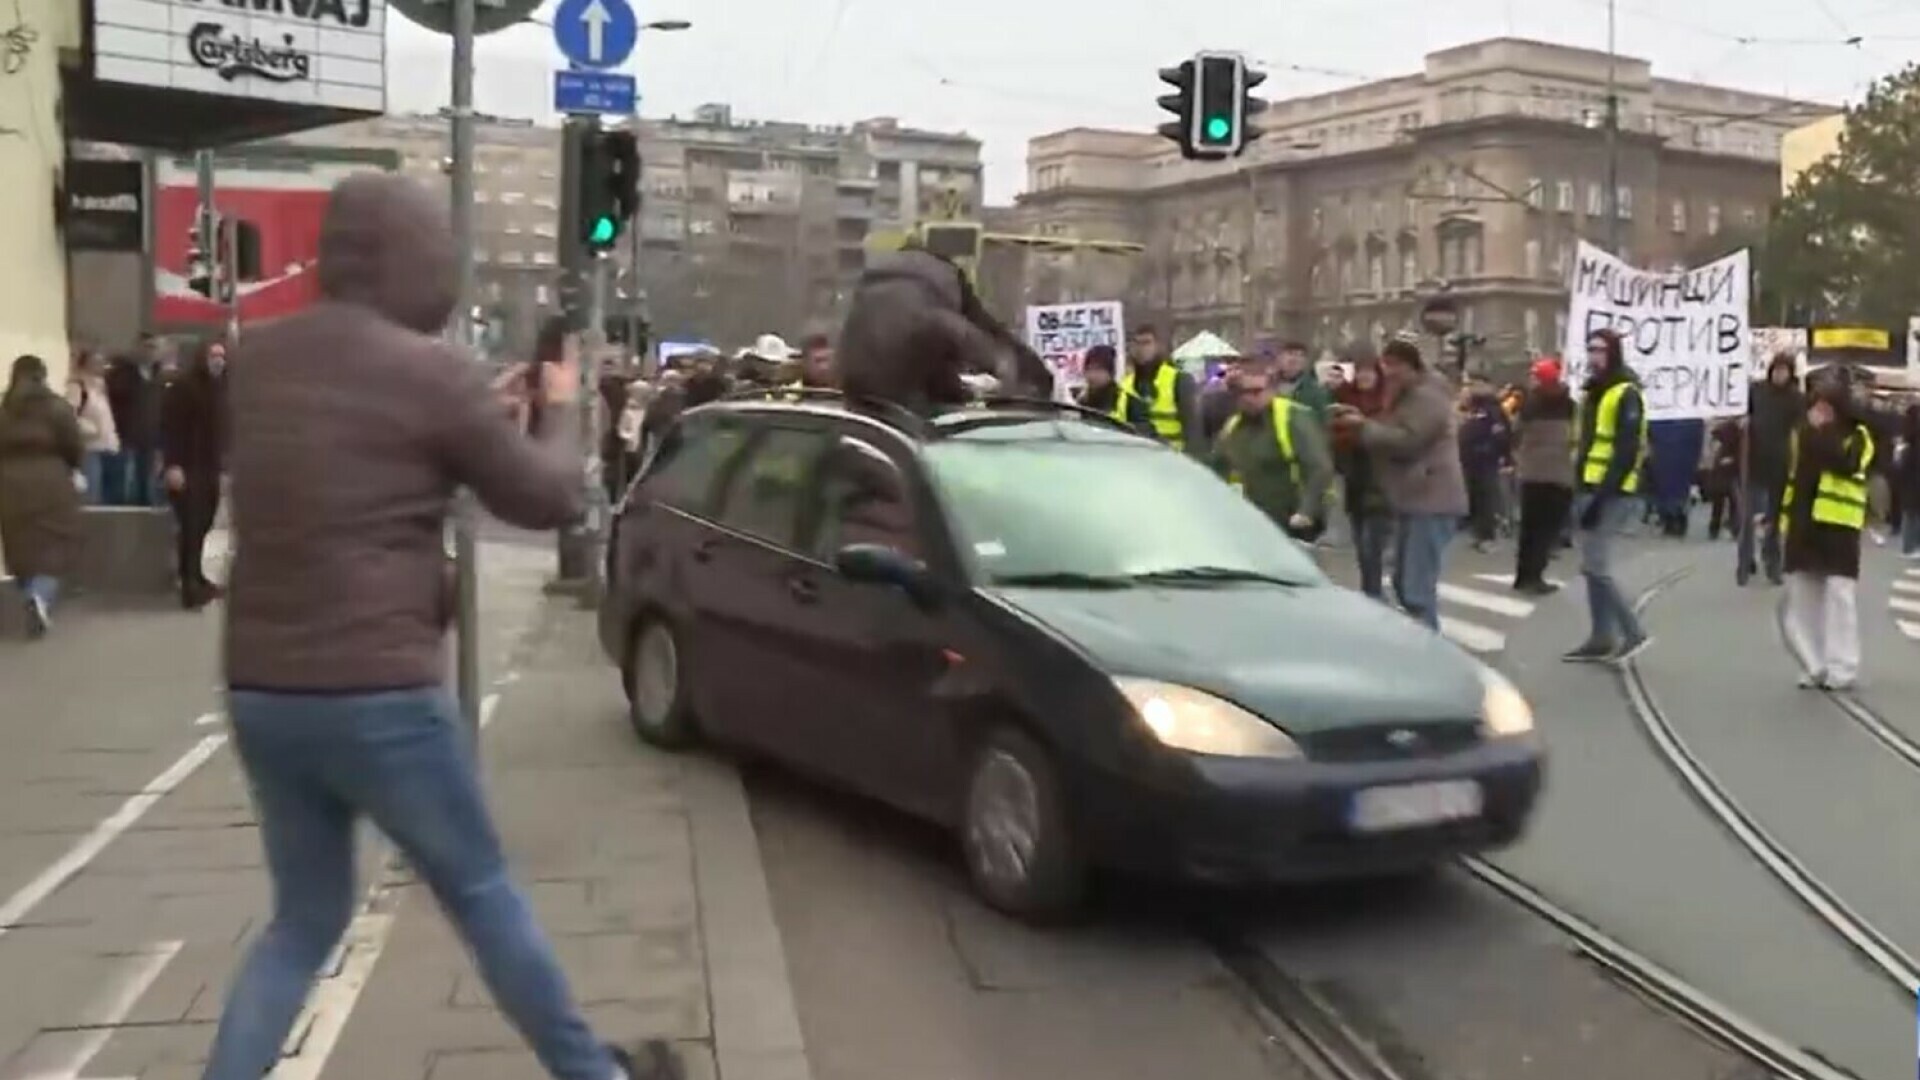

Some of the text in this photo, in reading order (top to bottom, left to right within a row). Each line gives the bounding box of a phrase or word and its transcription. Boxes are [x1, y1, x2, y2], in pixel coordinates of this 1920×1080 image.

[188, 22, 309, 82] Carlsberg
[1578, 257, 1735, 309] МАШИНЦИ
[1585, 309, 1741, 356] ПРОТИВ
